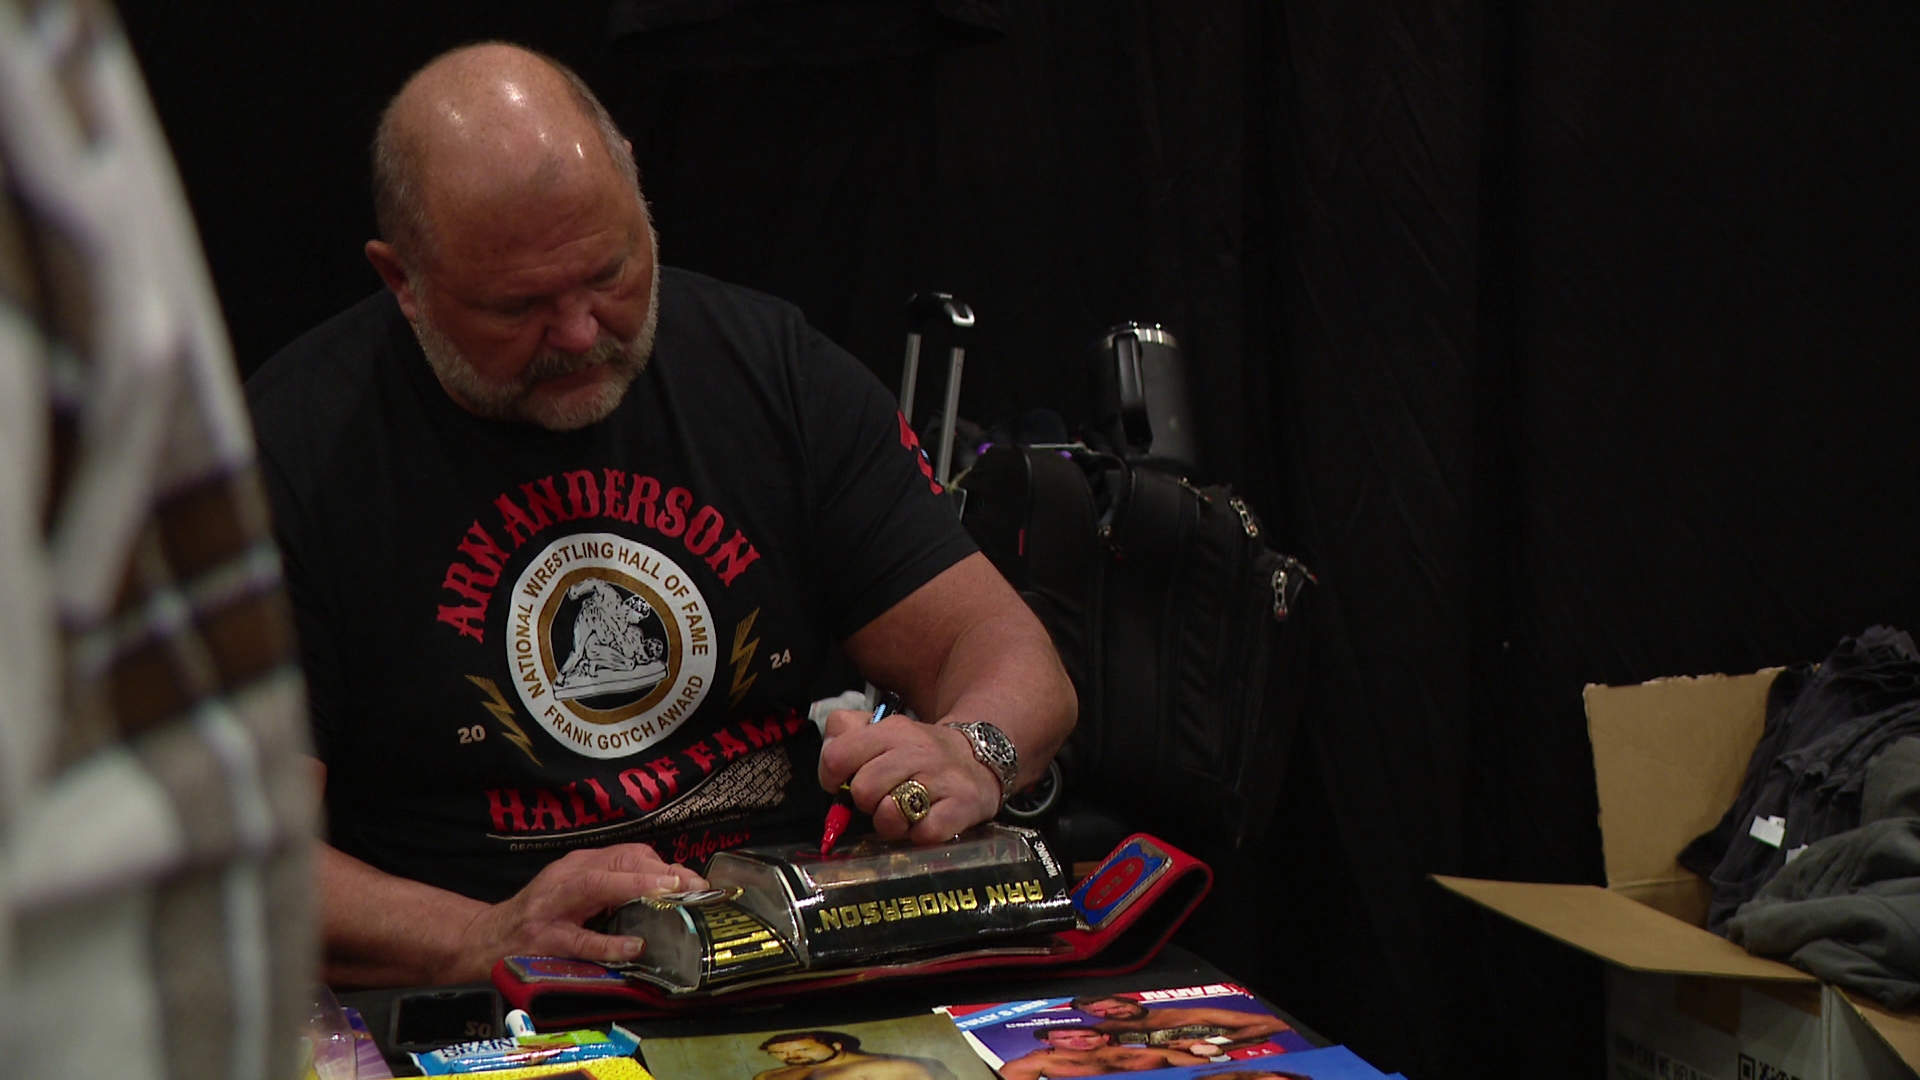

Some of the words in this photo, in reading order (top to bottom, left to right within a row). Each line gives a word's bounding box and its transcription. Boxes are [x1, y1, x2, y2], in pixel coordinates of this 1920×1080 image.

[437, 520, 511, 644] ARN
[493, 467, 761, 588] ANDERSON
[523, 542, 613, 598] WRESTLING
[619, 546, 661, 580] HALL
[664, 574, 690, 599] OF
[515, 603, 546, 699] NATIONAL
[682, 601, 709, 656] FAME
[770, 648, 792, 669] 24
[456, 724, 488, 745] 20
[544, 704, 593, 749] FRANK
[597, 721, 657, 750] GOTCH
[658, 675, 703, 731] AWARD
[485, 778, 626, 832] HALL
[618, 756, 681, 811] OF
[681, 706, 807, 775] FAME
[817, 887, 979, 930] ANDERSON
[984, 878, 1045, 907] ARN
